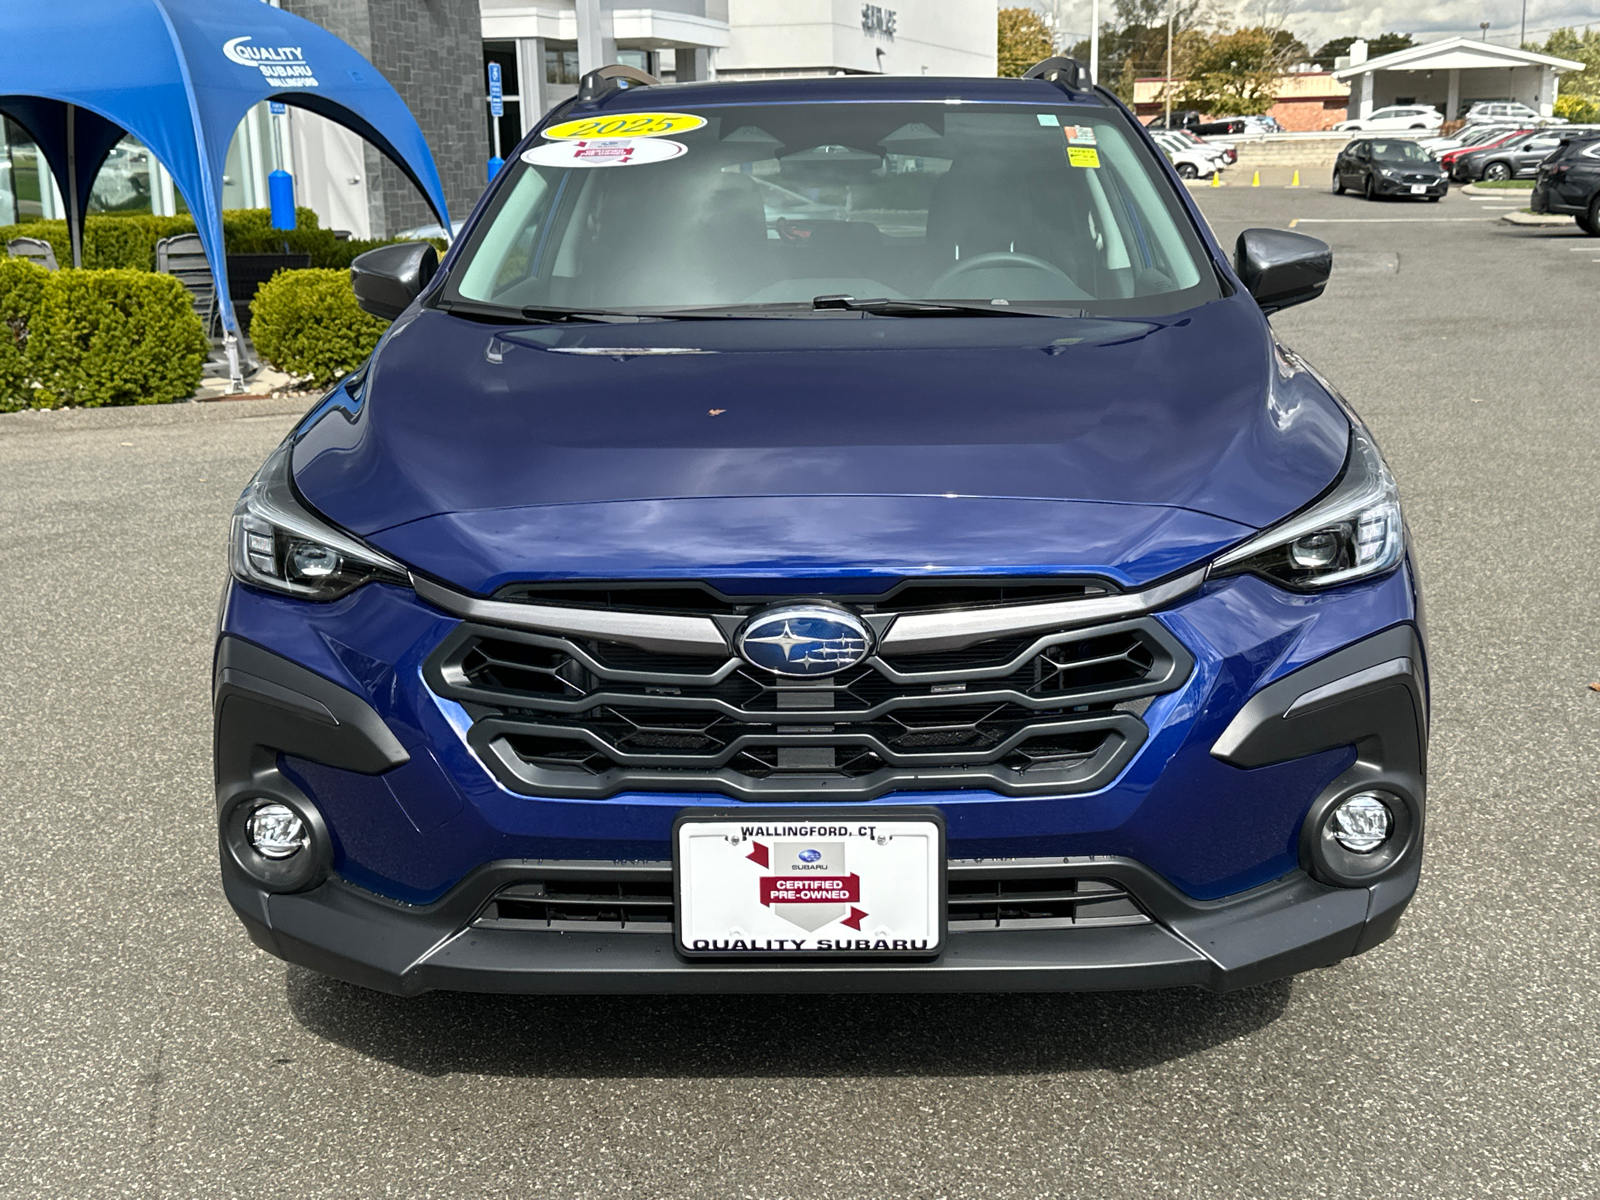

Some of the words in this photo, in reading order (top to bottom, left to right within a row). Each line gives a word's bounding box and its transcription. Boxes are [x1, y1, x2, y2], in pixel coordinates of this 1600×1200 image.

[236, 46, 303, 60] QUALITY
[259, 65, 313, 77] SUBARU
[567, 117, 682, 137] 2025
[858, 826, 877, 837] CT
[776, 880, 843, 889] CERTIFIED
[770, 890, 849, 899] PRE-OWNED
[692, 939, 807, 951] QUALITY
[816, 939, 928, 951] SUBARU
